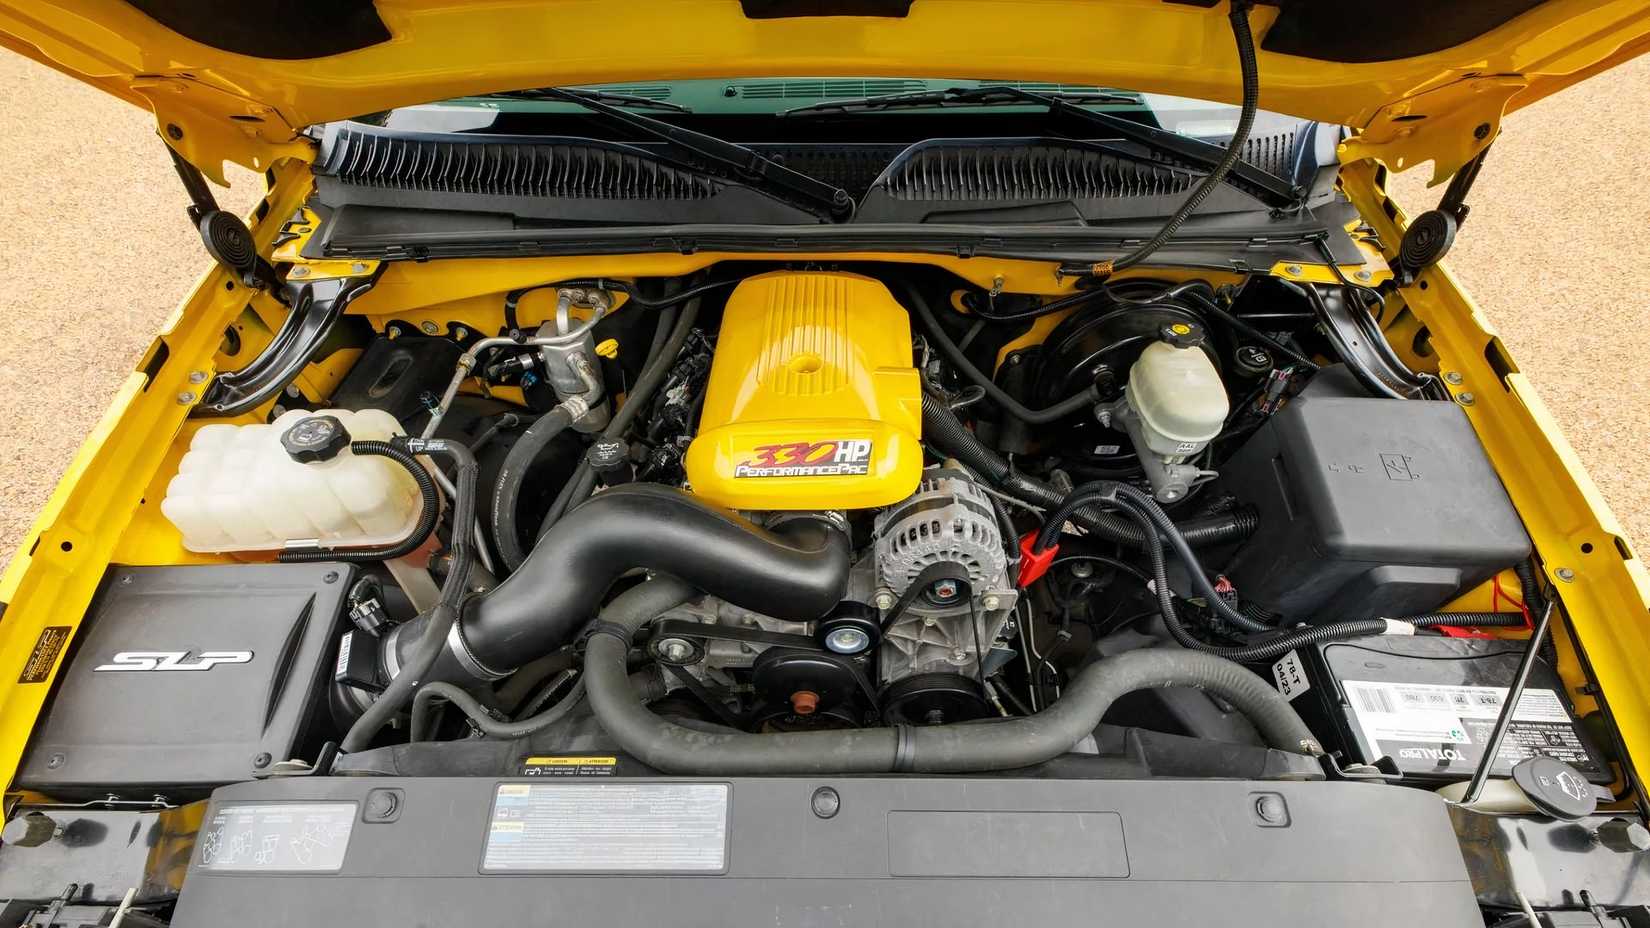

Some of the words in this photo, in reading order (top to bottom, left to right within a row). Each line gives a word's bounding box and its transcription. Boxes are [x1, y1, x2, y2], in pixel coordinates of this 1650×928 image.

[742, 442, 838, 468] 330
[834, 441, 871, 463] HP
[94, 650, 254, 671] SLP
